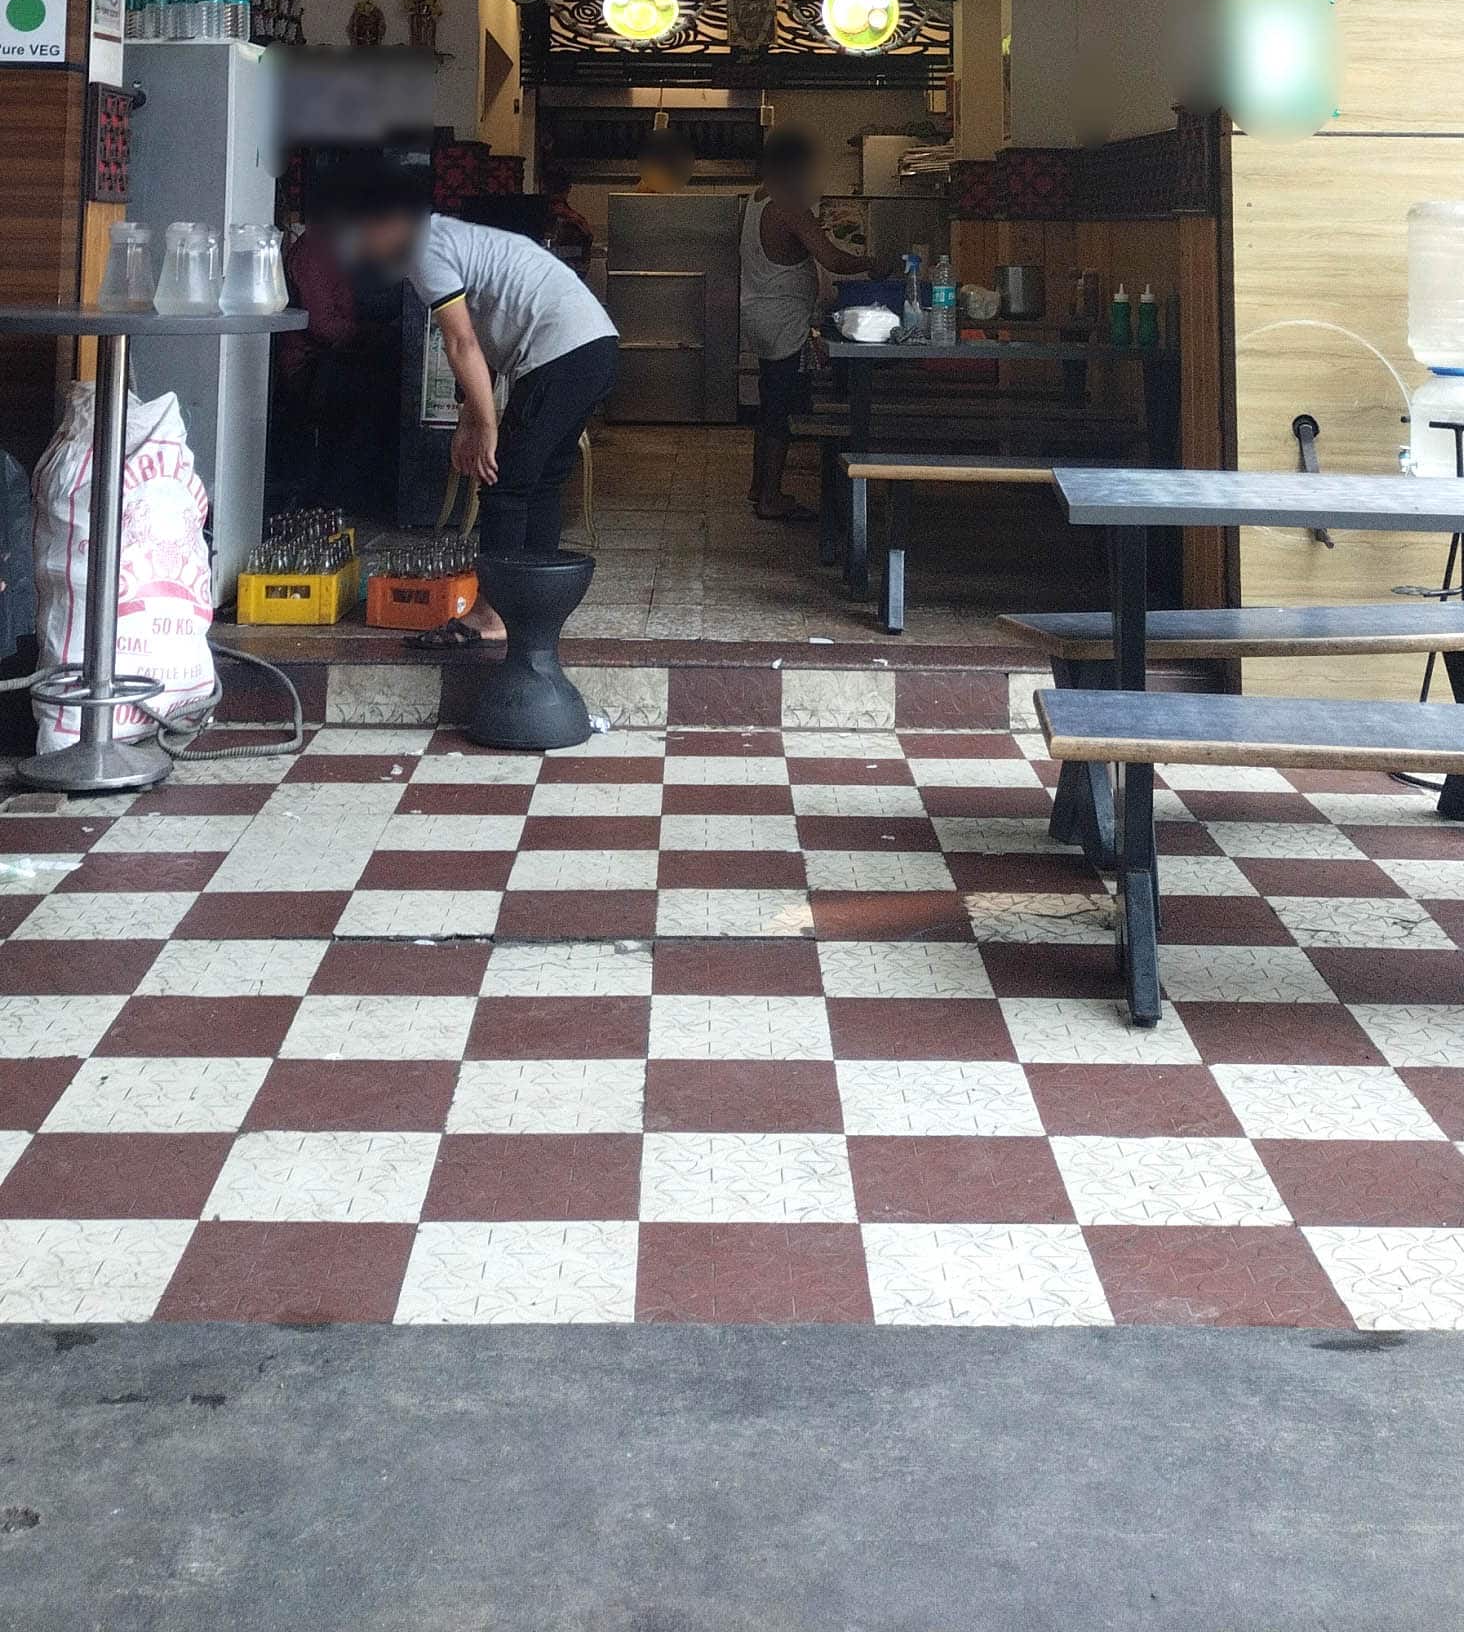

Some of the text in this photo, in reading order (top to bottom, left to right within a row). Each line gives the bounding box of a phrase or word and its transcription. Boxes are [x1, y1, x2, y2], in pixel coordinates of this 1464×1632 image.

[0, 44, 60, 56] ure VEG
[124, 450, 191, 490] UBLE
[152, 617, 172, 635] 50
[117, 635, 153, 654] CIAL
